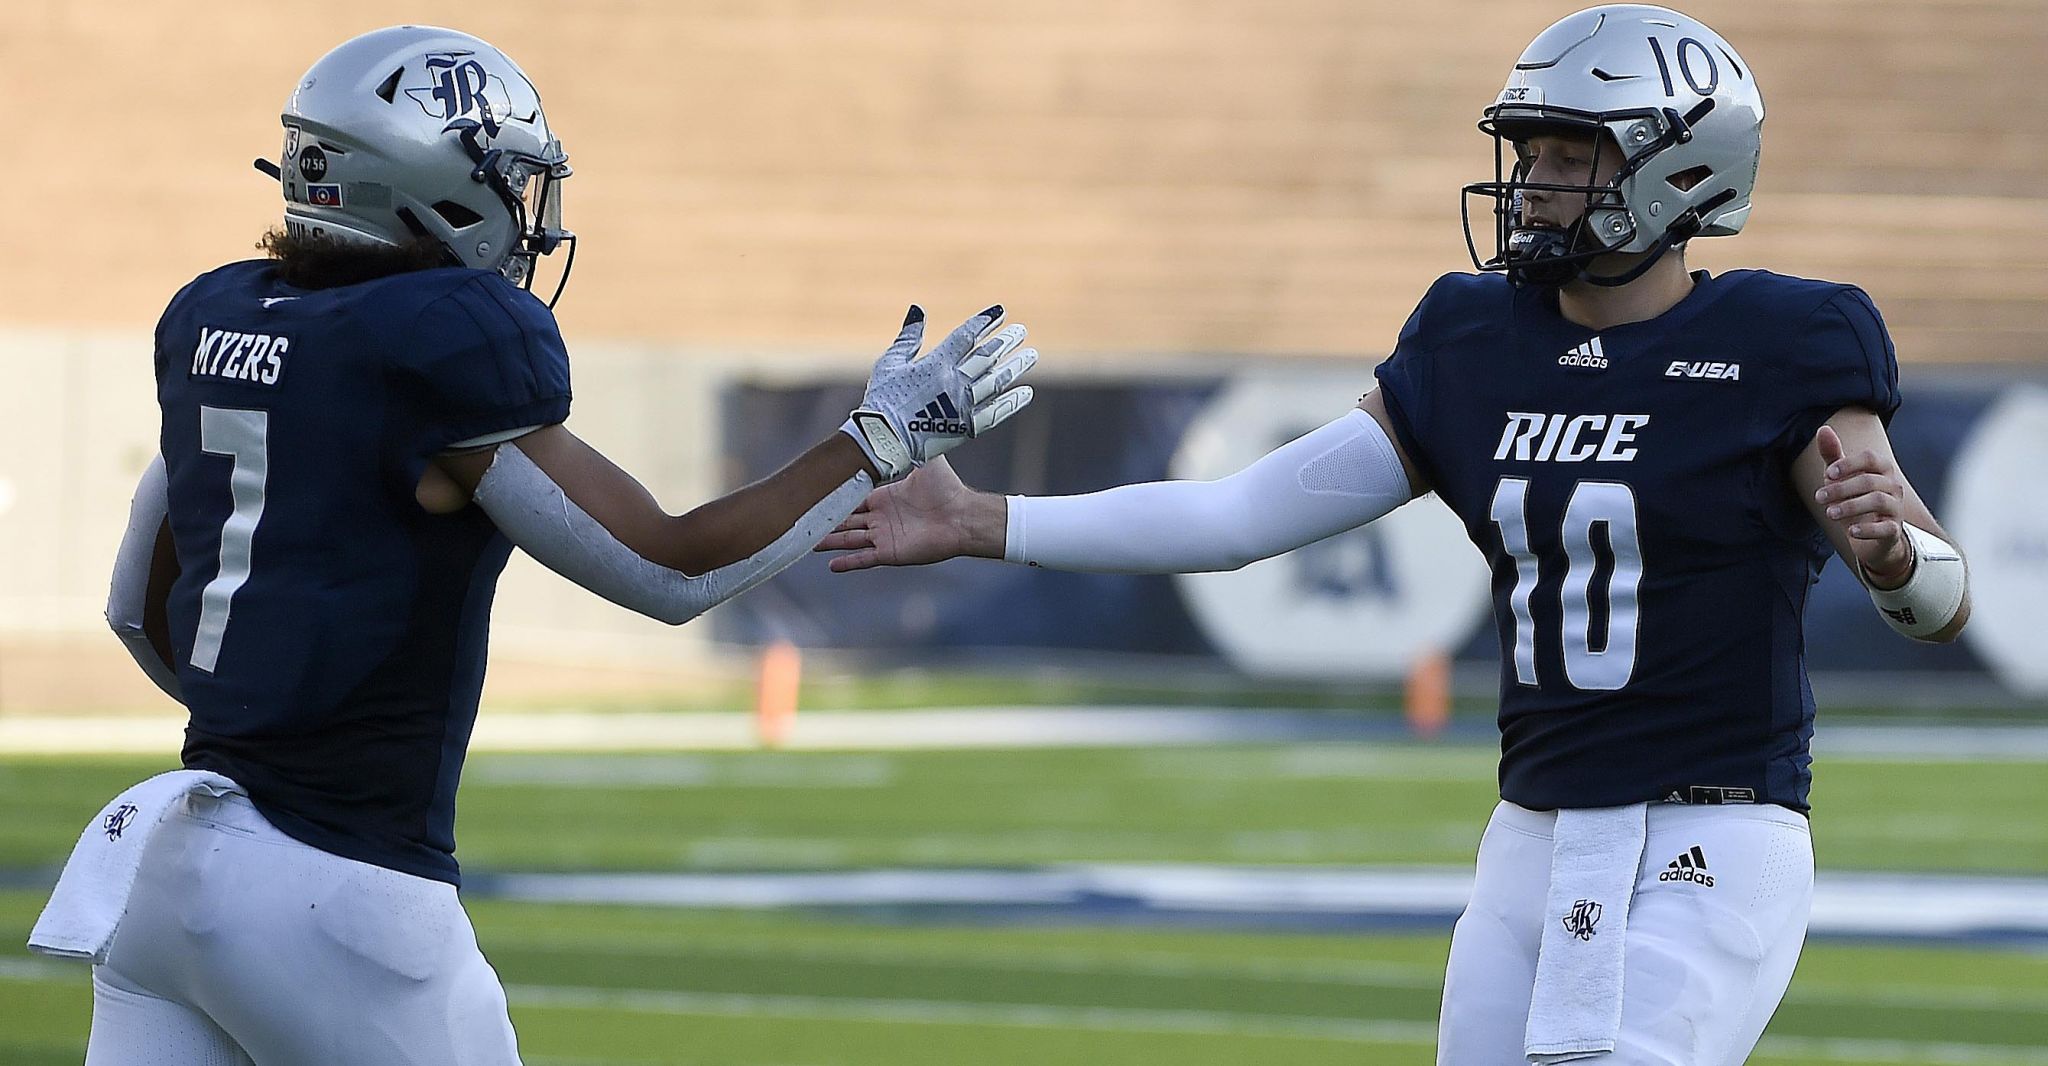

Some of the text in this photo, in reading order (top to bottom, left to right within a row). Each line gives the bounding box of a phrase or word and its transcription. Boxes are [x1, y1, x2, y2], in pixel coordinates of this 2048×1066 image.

[1647, 36, 1718, 96] 10
[191, 327, 289, 385] MYERS
[1558, 352, 1609, 370] adidas
[908, 418, 968, 435] adidas
[1493, 411, 1651, 462] RICE
[189, 405, 268, 673] 7
[1490, 477, 1644, 691] 10
[1658, 867, 1715, 888] adidas
